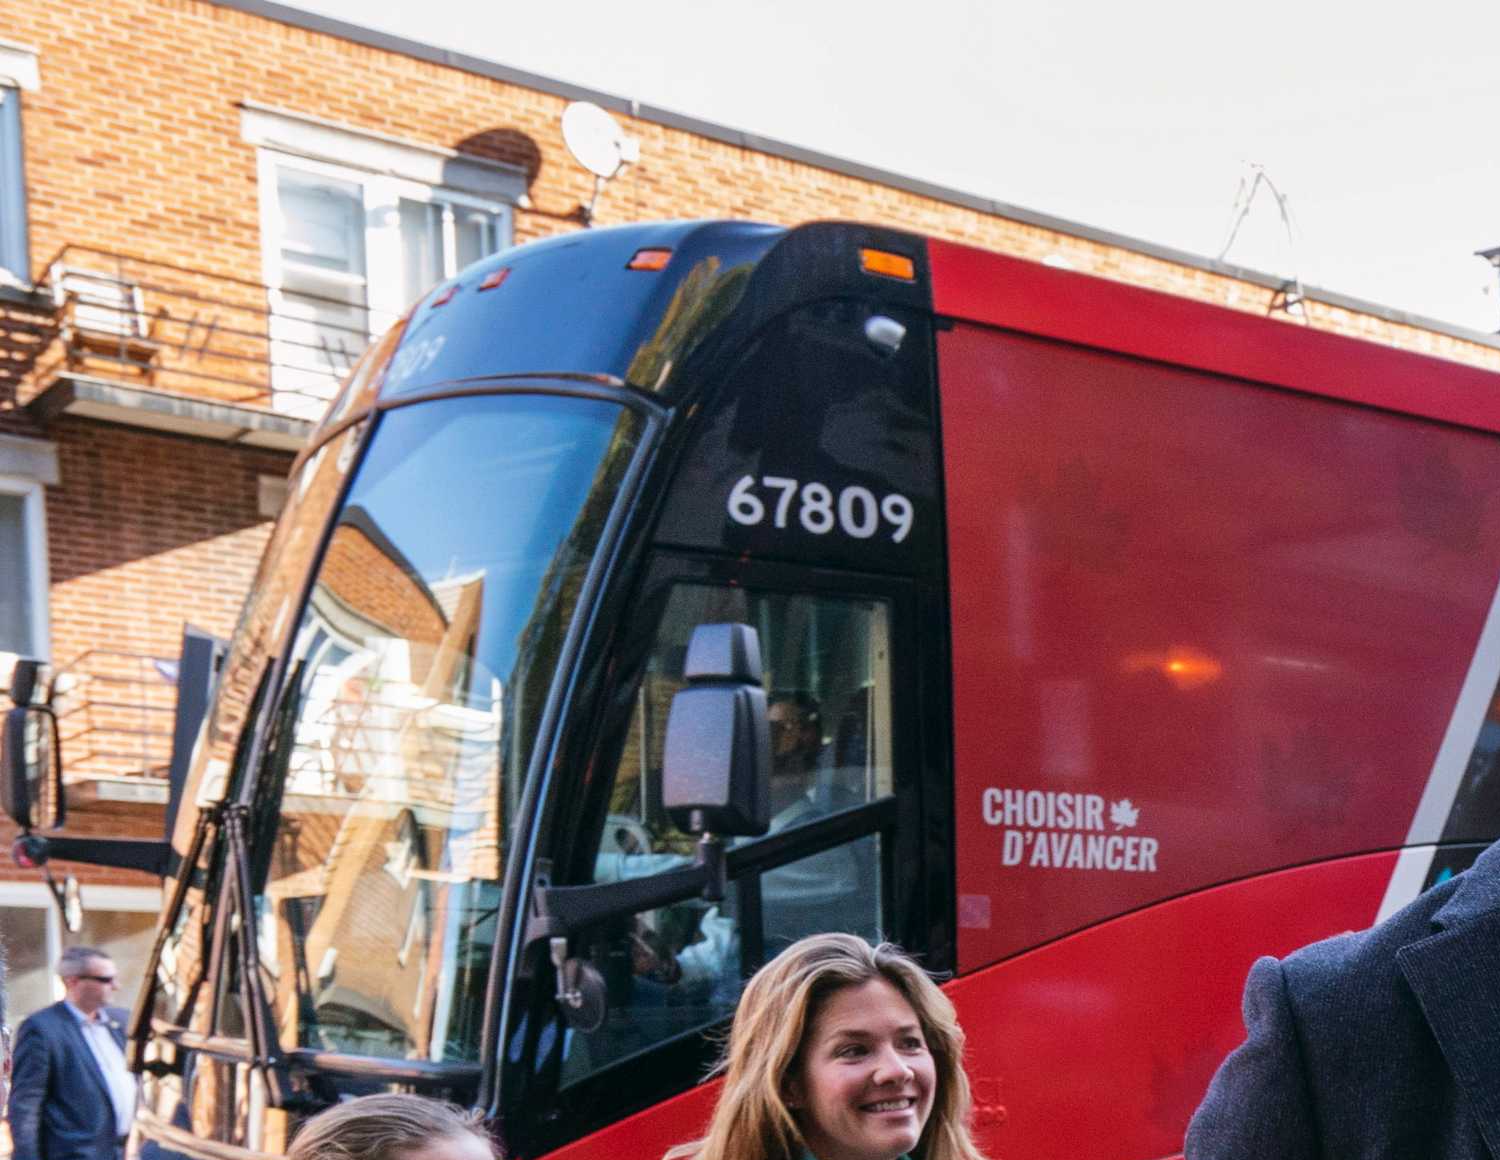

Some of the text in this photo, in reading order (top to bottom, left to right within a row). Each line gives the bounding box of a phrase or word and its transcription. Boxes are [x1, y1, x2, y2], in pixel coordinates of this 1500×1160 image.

[726, 474, 914, 544] 67809
[982, 787, 1105, 831] CHOISIR
[1002, 830, 1159, 872] D'AVANCER
